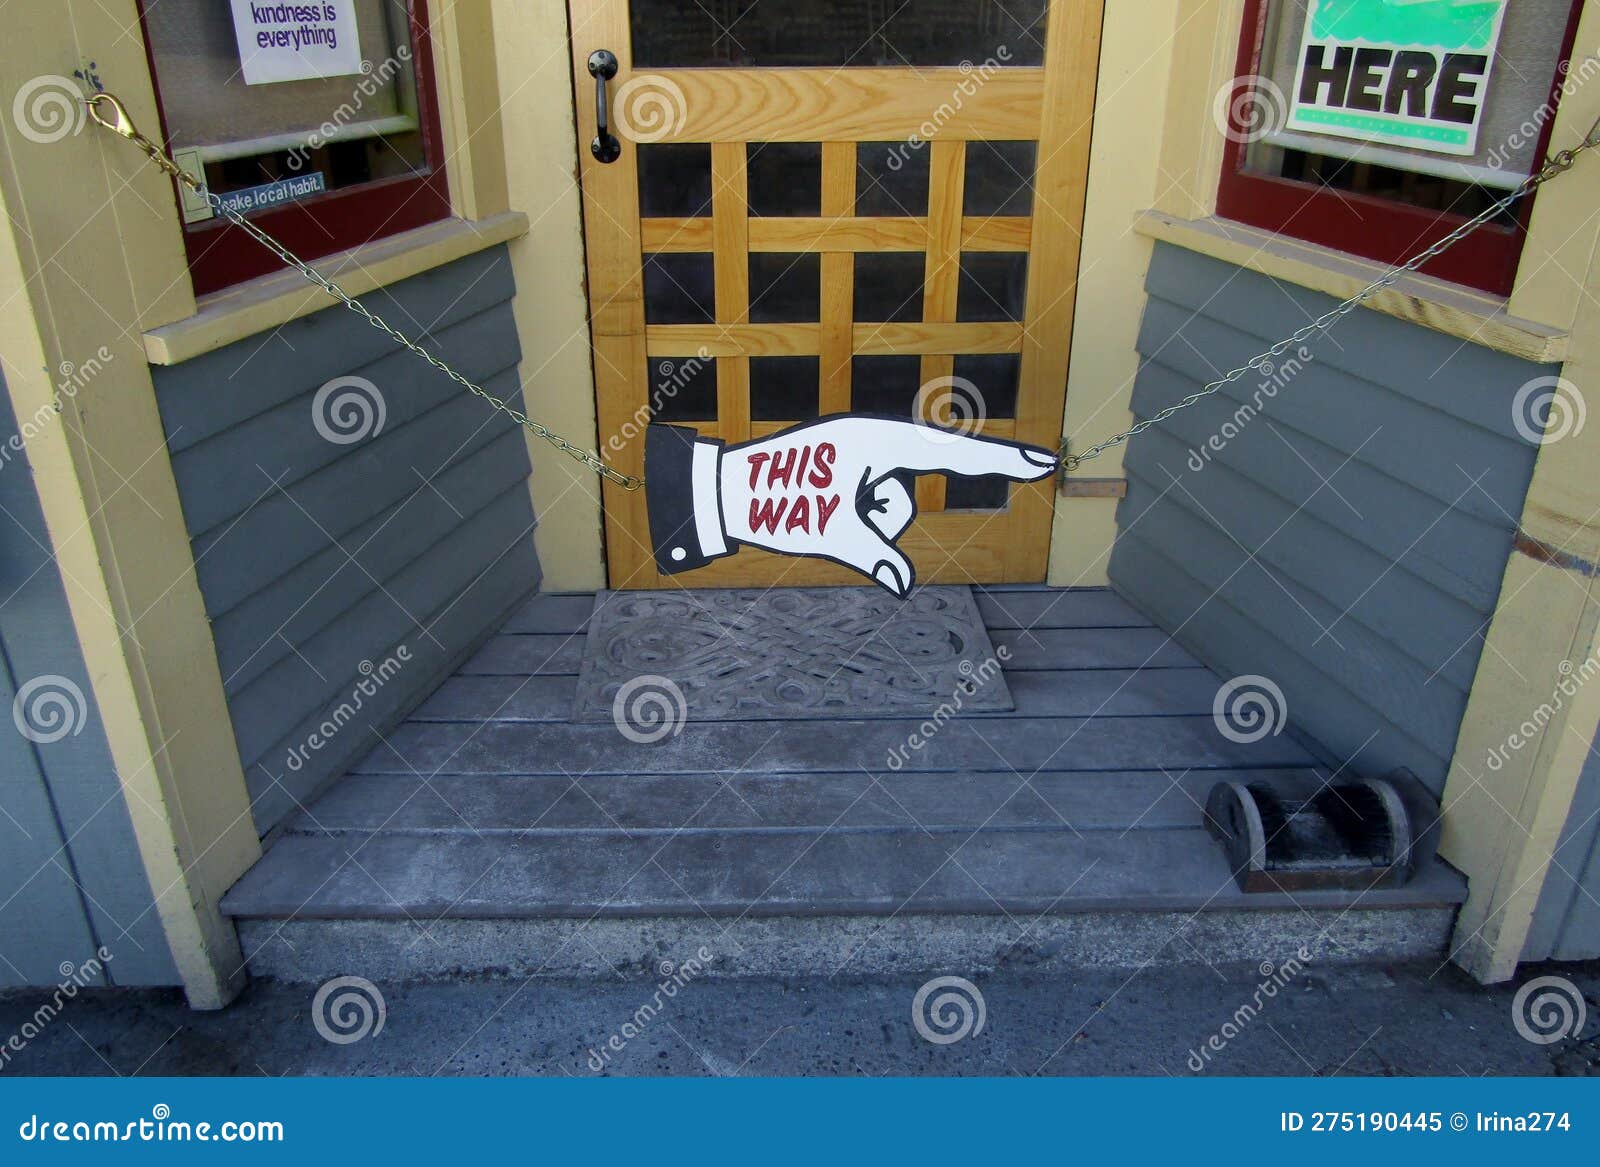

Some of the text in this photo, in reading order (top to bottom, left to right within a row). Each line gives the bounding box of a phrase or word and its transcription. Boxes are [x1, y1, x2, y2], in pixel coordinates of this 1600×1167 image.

[250, 1, 337, 24] kindness is
[256, 25, 337, 51] everything
[1299, 45, 1487, 124] HERE
[254, 183, 287, 206] local
[289, 177, 321, 197] habit.
[747, 442, 836, 492] THIS
[749, 494, 840, 537] WAY
